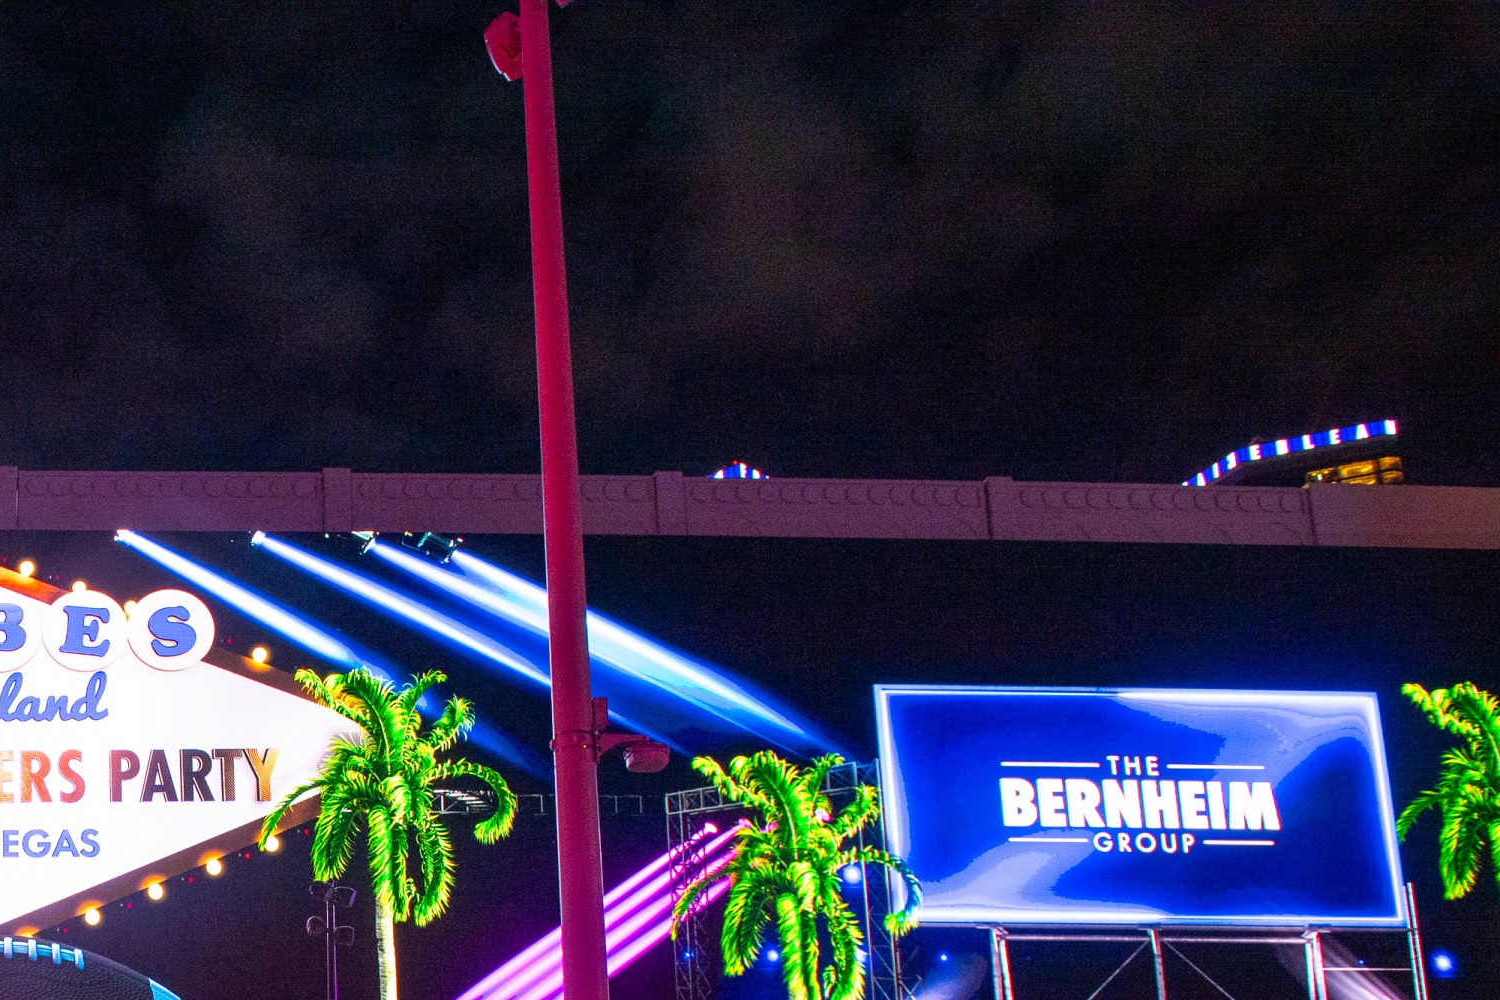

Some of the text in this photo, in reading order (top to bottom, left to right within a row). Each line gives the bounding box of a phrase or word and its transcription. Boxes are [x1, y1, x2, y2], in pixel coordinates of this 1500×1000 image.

[107, 747, 281, 803] PARTY
[1106, 755, 1160, 777] THE
[999, 777, 1281, 831] BERNHEIM
[1093, 831, 1196, 854] GROUP
